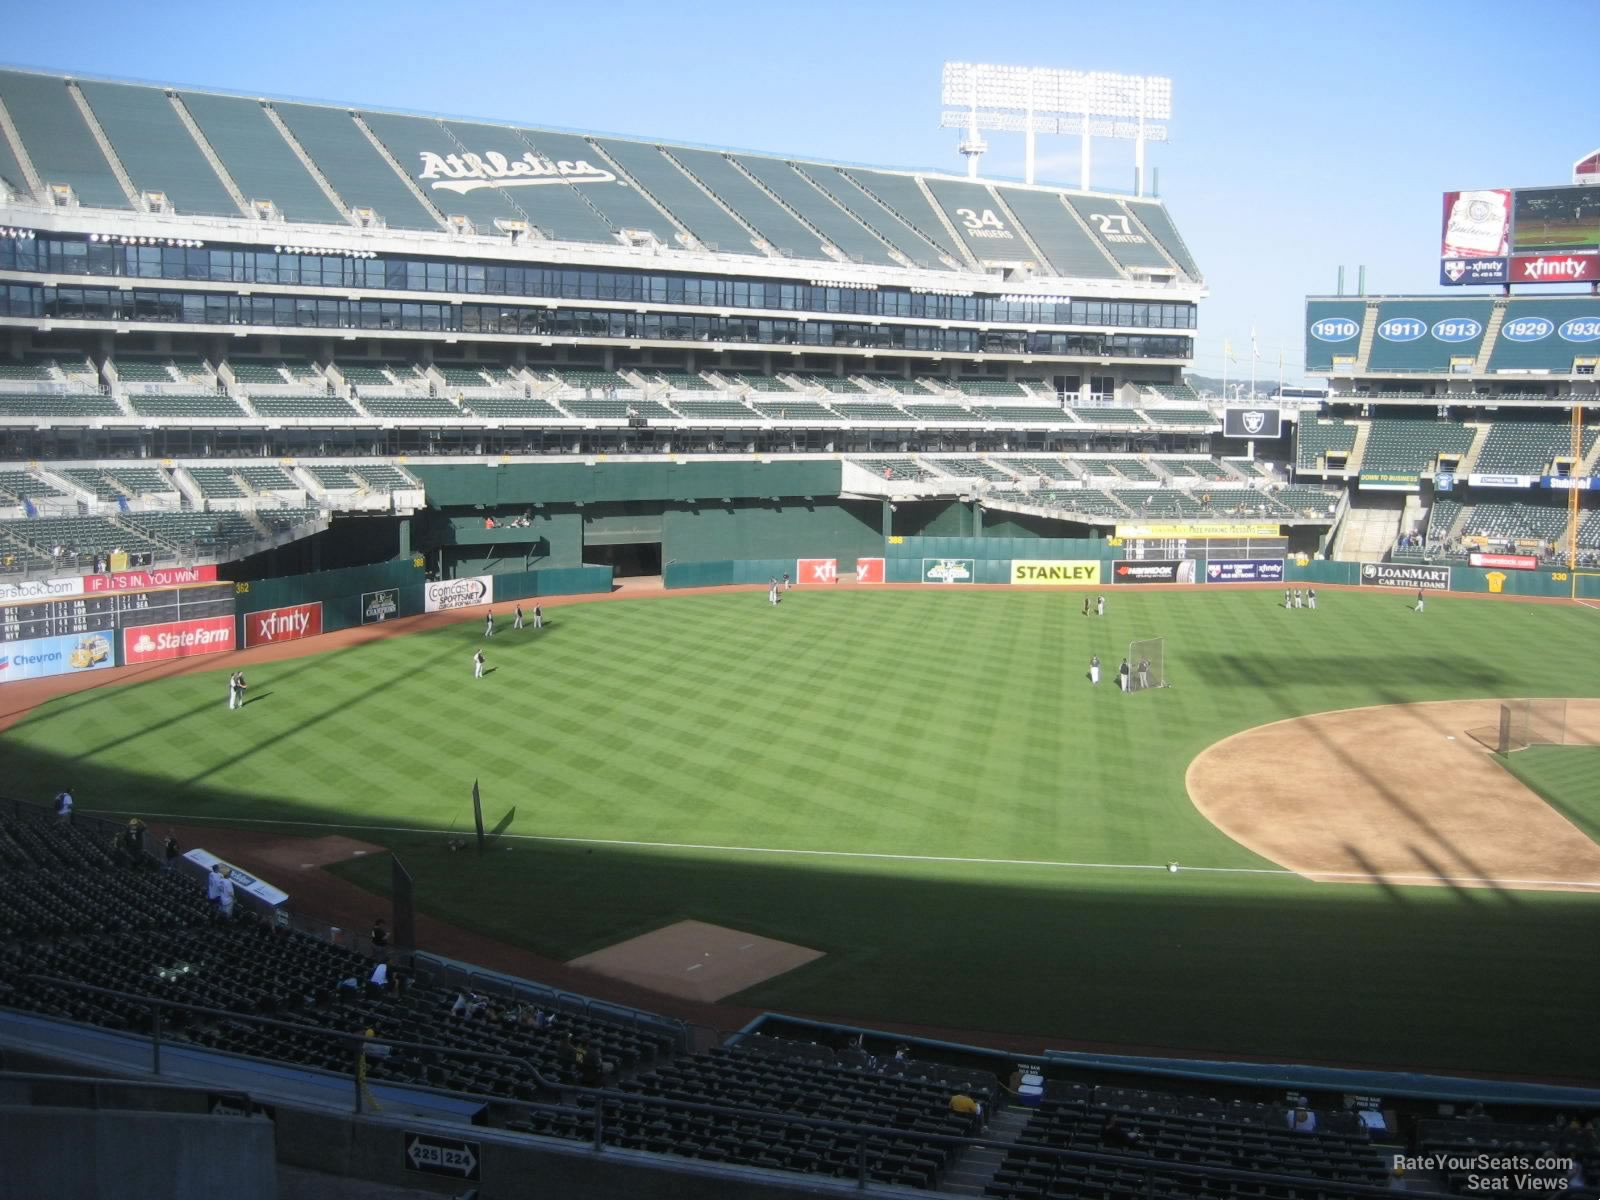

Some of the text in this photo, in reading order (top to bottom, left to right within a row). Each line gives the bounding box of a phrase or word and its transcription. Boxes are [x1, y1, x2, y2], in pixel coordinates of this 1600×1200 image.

[418, 151, 605, 180] Athletics
[956, 208, 1004, 230] 34
[1090, 213, 1133, 235] 27
[967, 228, 1014, 240] FINGERS
[1104, 233, 1147, 244] HUNTER
[1472, 260, 1503, 272] xfinity
[1523, 258, 1587, 279] xfinity
[1317, 322, 1354, 337] 1910
[1384, 322, 1421, 337] 1911
[1437, 322, 1476, 337] 1913
[1508, 322, 1547, 337] 1929
[92, 578, 102, 590] IF
[130, 574, 145, 588] IN,
[150, 571, 172, 585] YOU
[175, 569, 199, 583] WIN!
[1016, 565, 1095, 580] STANLEY
[1551, 572, 1567, 581] 330
[236, 582, 250, 594] 362
[1378, 578, 1445, 589] CAR TITLE LOANS
[136, 601, 149, 609] SEA
[440, 592, 480, 604] SPORTSNET
[73, 616, 87, 625] TEX
[260, 610, 310, 640] xfinity
[13, 651, 62, 666] Chevron
[413, 1147, 470, 1166] 225 224
